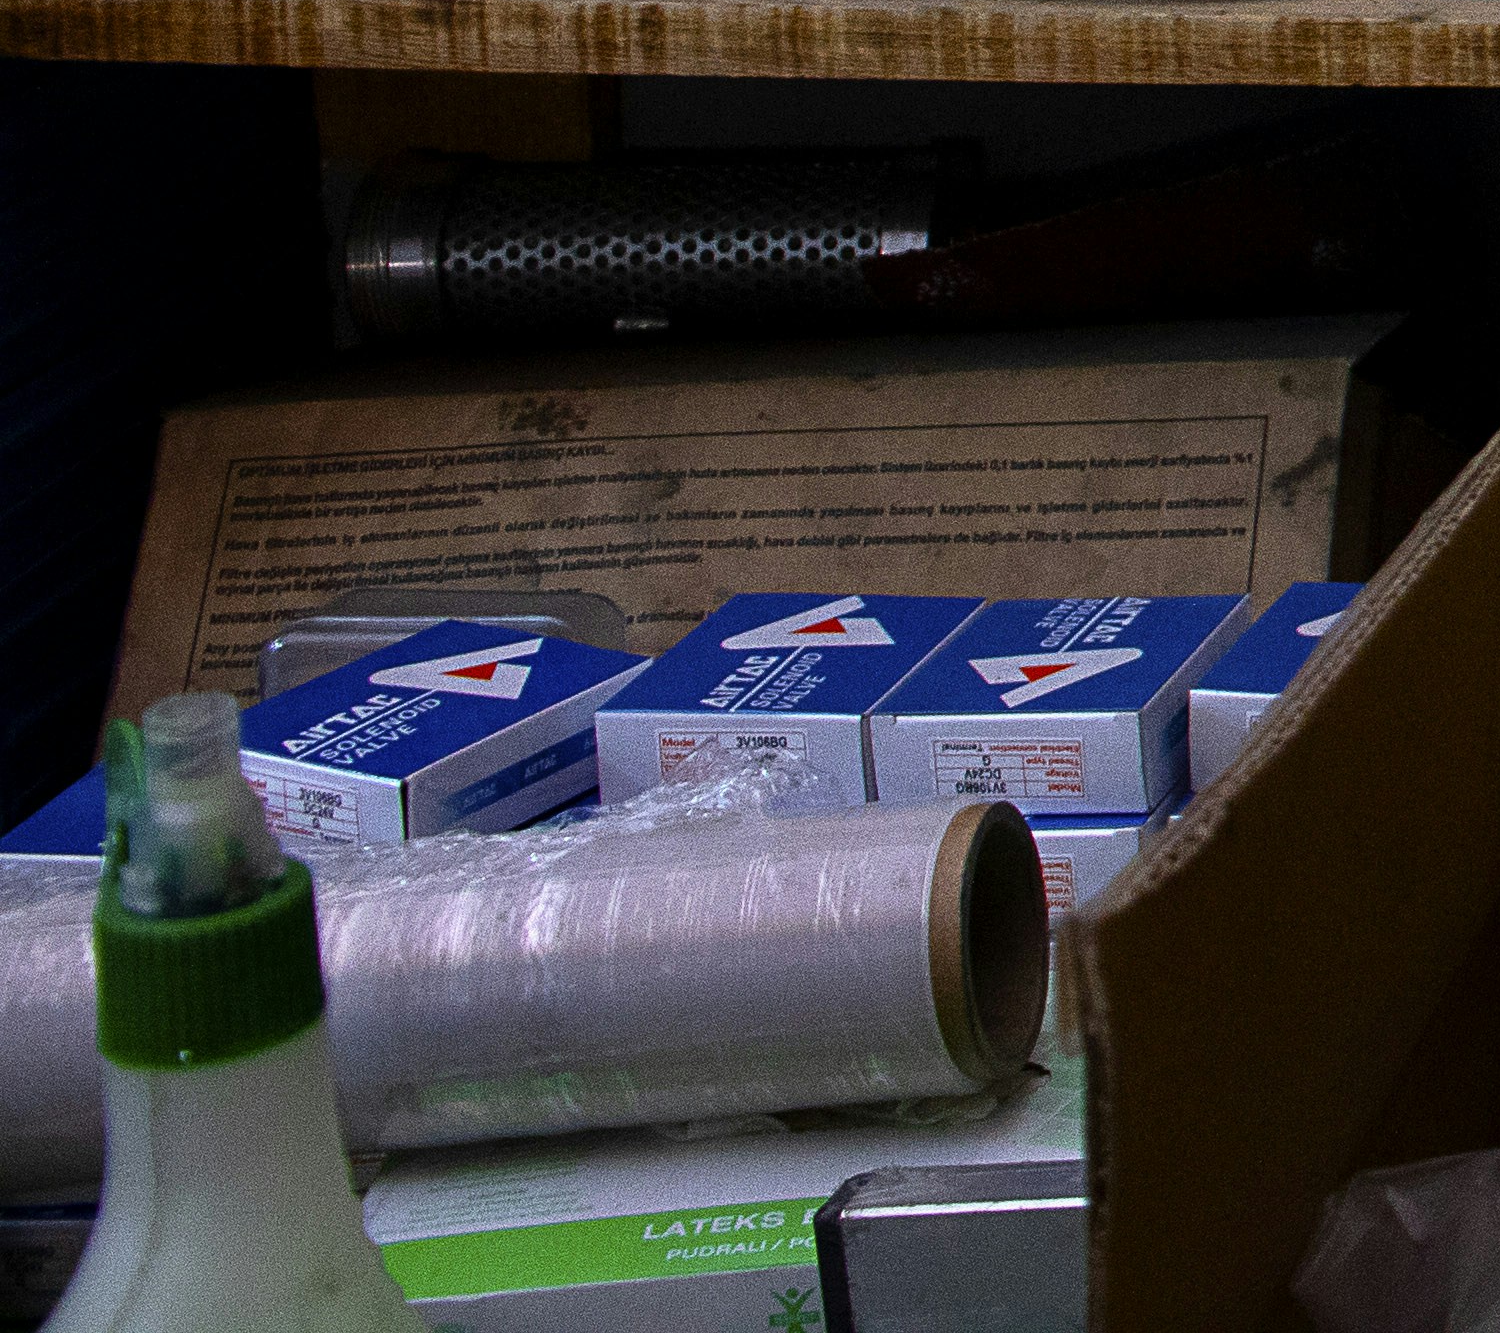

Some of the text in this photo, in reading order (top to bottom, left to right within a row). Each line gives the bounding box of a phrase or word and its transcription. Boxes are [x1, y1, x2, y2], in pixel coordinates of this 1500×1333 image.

[750, 652, 823, 708] SOLENOID
[772, 675, 826, 710] VALVE
[319, 697, 442, 761] SOLENOID
[334, 724, 417, 765] VALVE
[662, 737, 695, 748] Model
[942, 742, 983, 753] Terminal
[1037, 743, 1080, 753] Electrical
[1025, 755, 1046, 766] type
[1047, 756, 1080, 767] Thread
[964, 767, 1080, 780] Voltage DC24V
[1047, 782, 1083, 793] Model
[642, 1211, 785, 1240] LATEKS
[665, 1240, 767, 1261] PUDRALI
